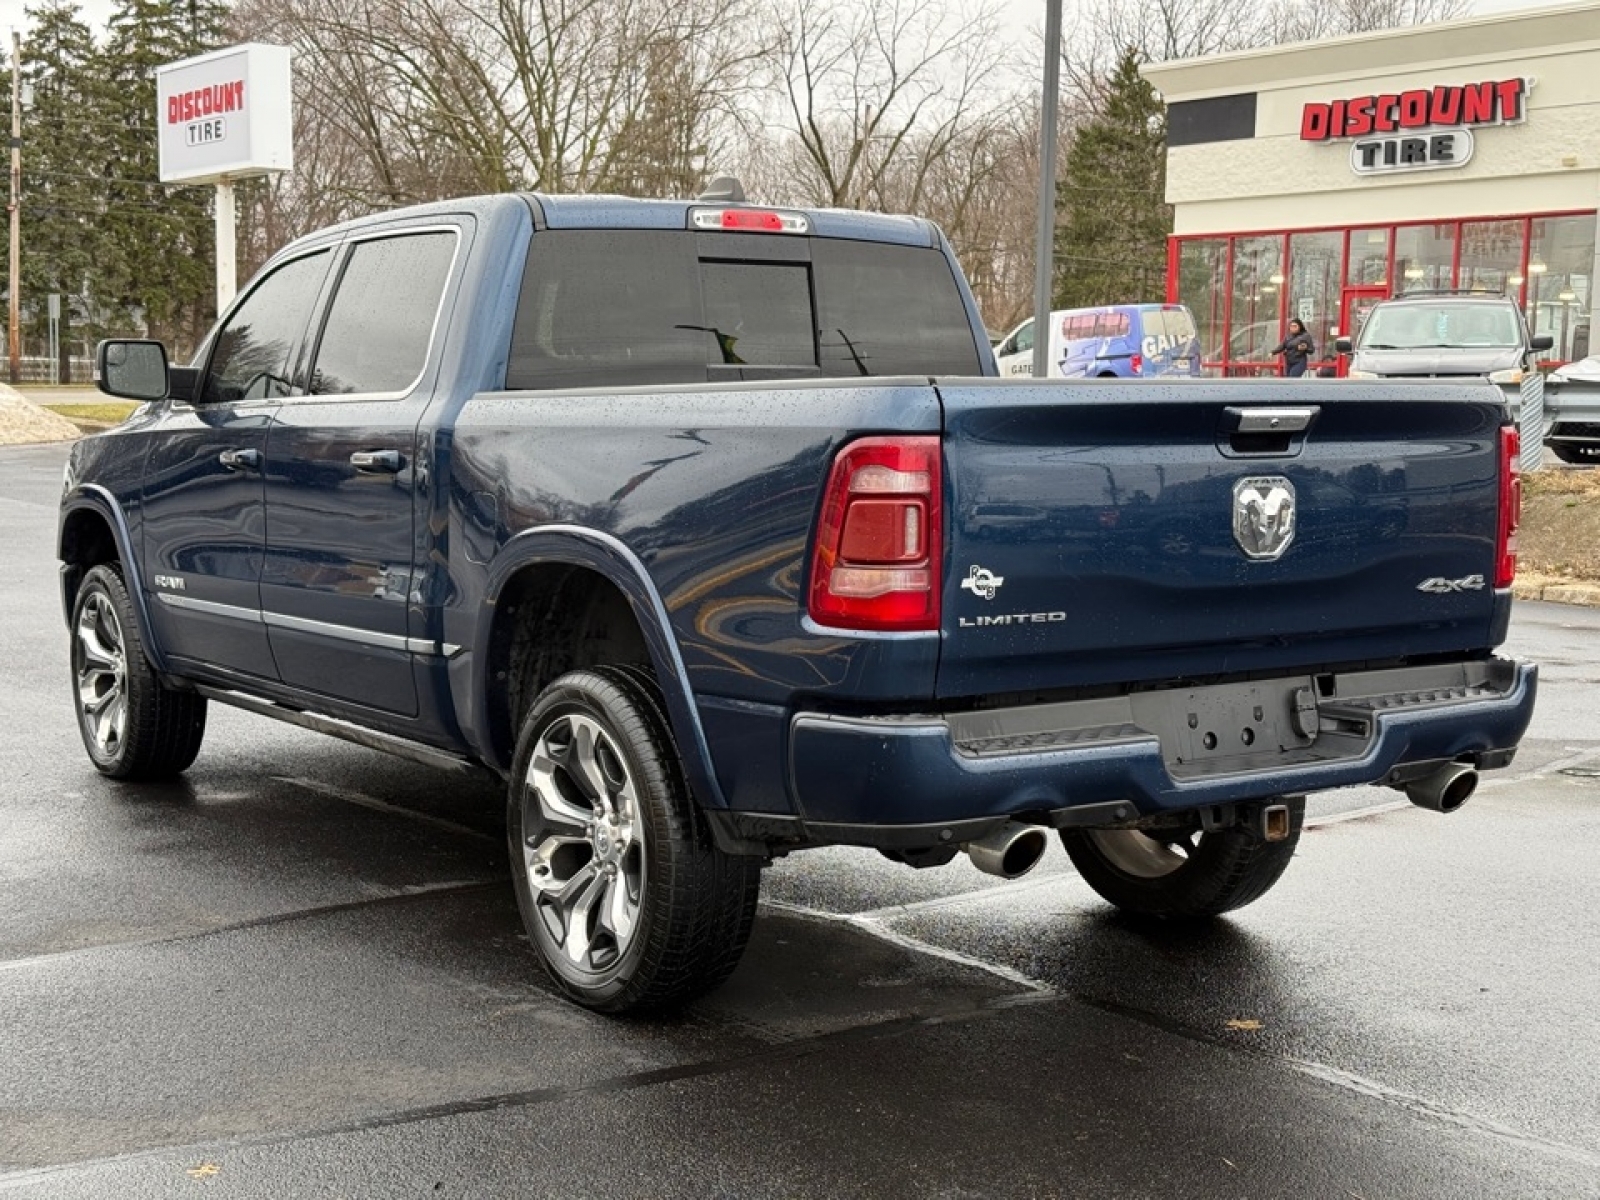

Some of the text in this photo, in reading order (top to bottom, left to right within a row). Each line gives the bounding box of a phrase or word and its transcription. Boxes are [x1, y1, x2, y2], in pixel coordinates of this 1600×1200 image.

[168, 80, 244, 124] DISCOUNT
[1300, 77, 1524, 140] DISCOUNT
[188, 120, 222, 143] TIRE
[1356, 134, 1455, 168] TIRE
[1416, 575, 1485, 593] 4x4
[959, 611, 1067, 627] LIMITED
